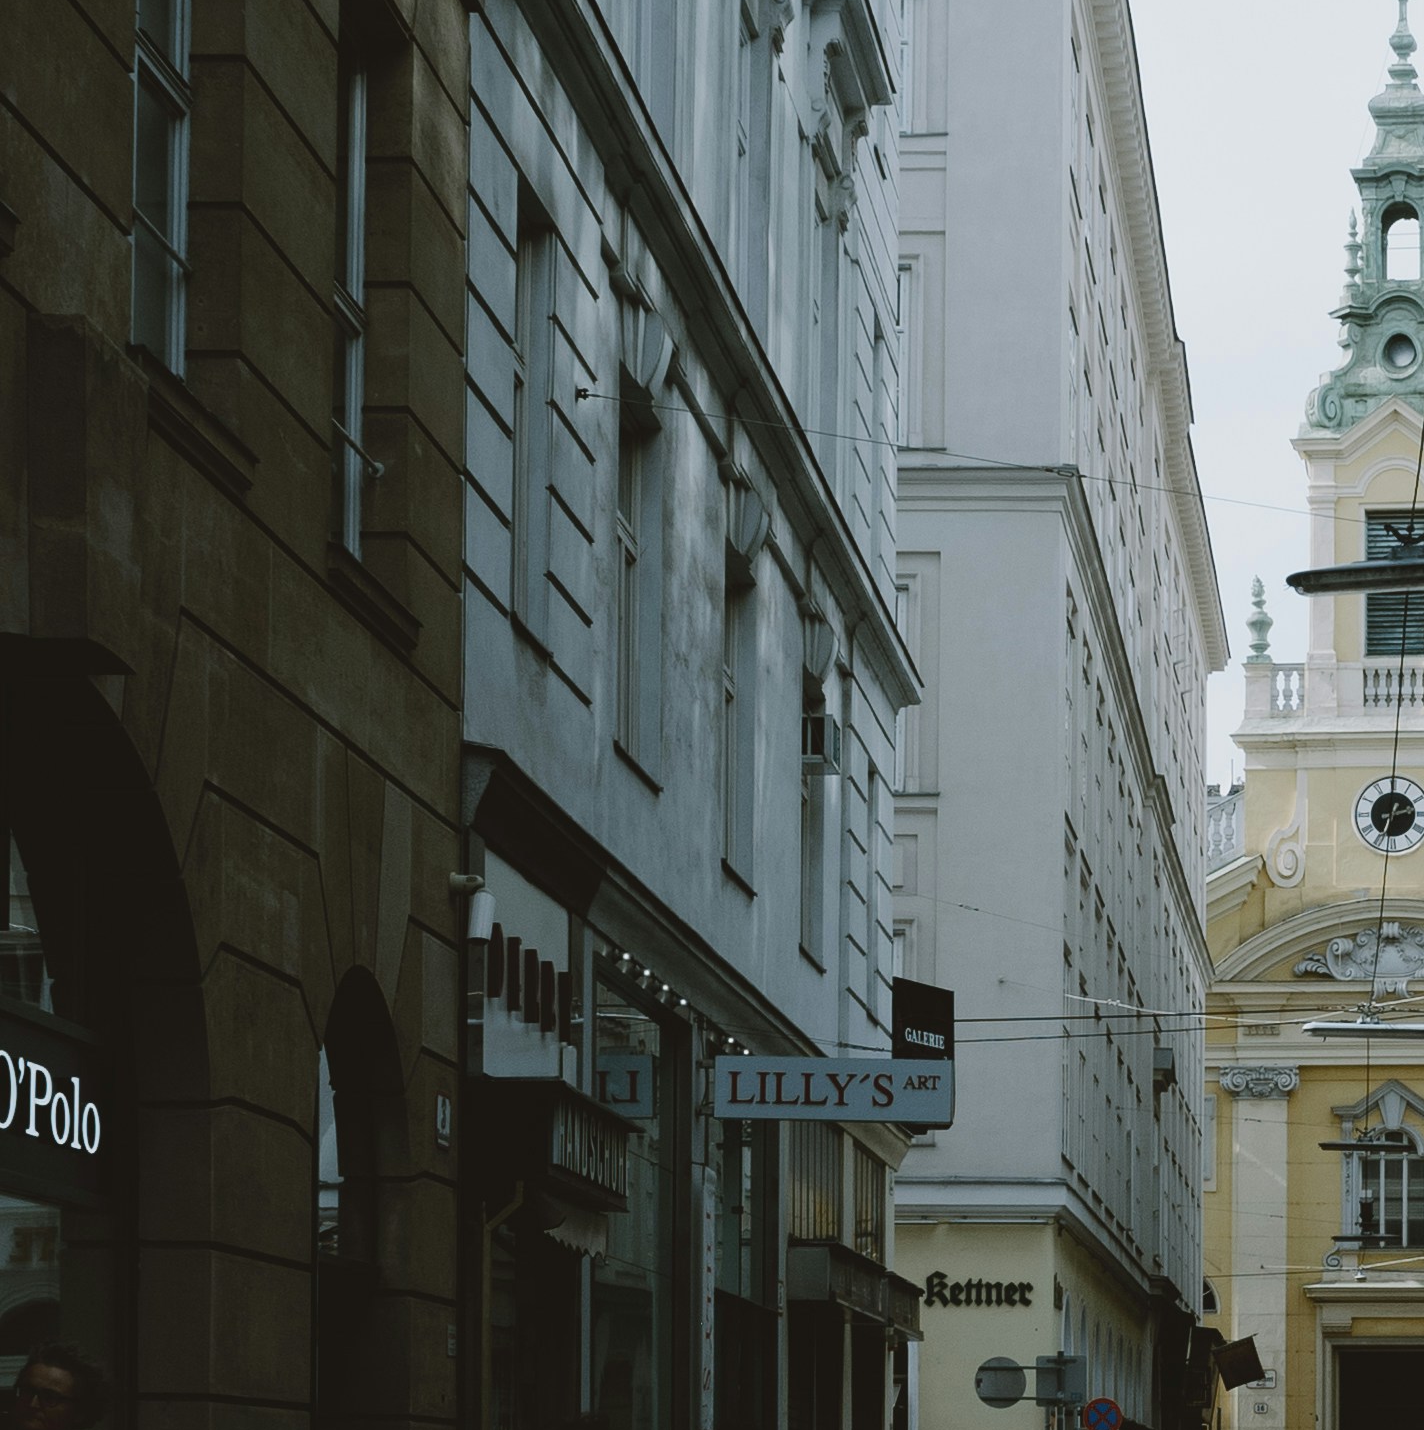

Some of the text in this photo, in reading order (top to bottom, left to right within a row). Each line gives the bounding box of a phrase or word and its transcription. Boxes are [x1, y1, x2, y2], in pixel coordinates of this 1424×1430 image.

[903, 1028, 944, 1050] GALERIE
[901, 1074, 941, 1090] ART
[0, 1050, 100, 1155] O'Polo
[924, 1270, 1034, 1308] Kettner
